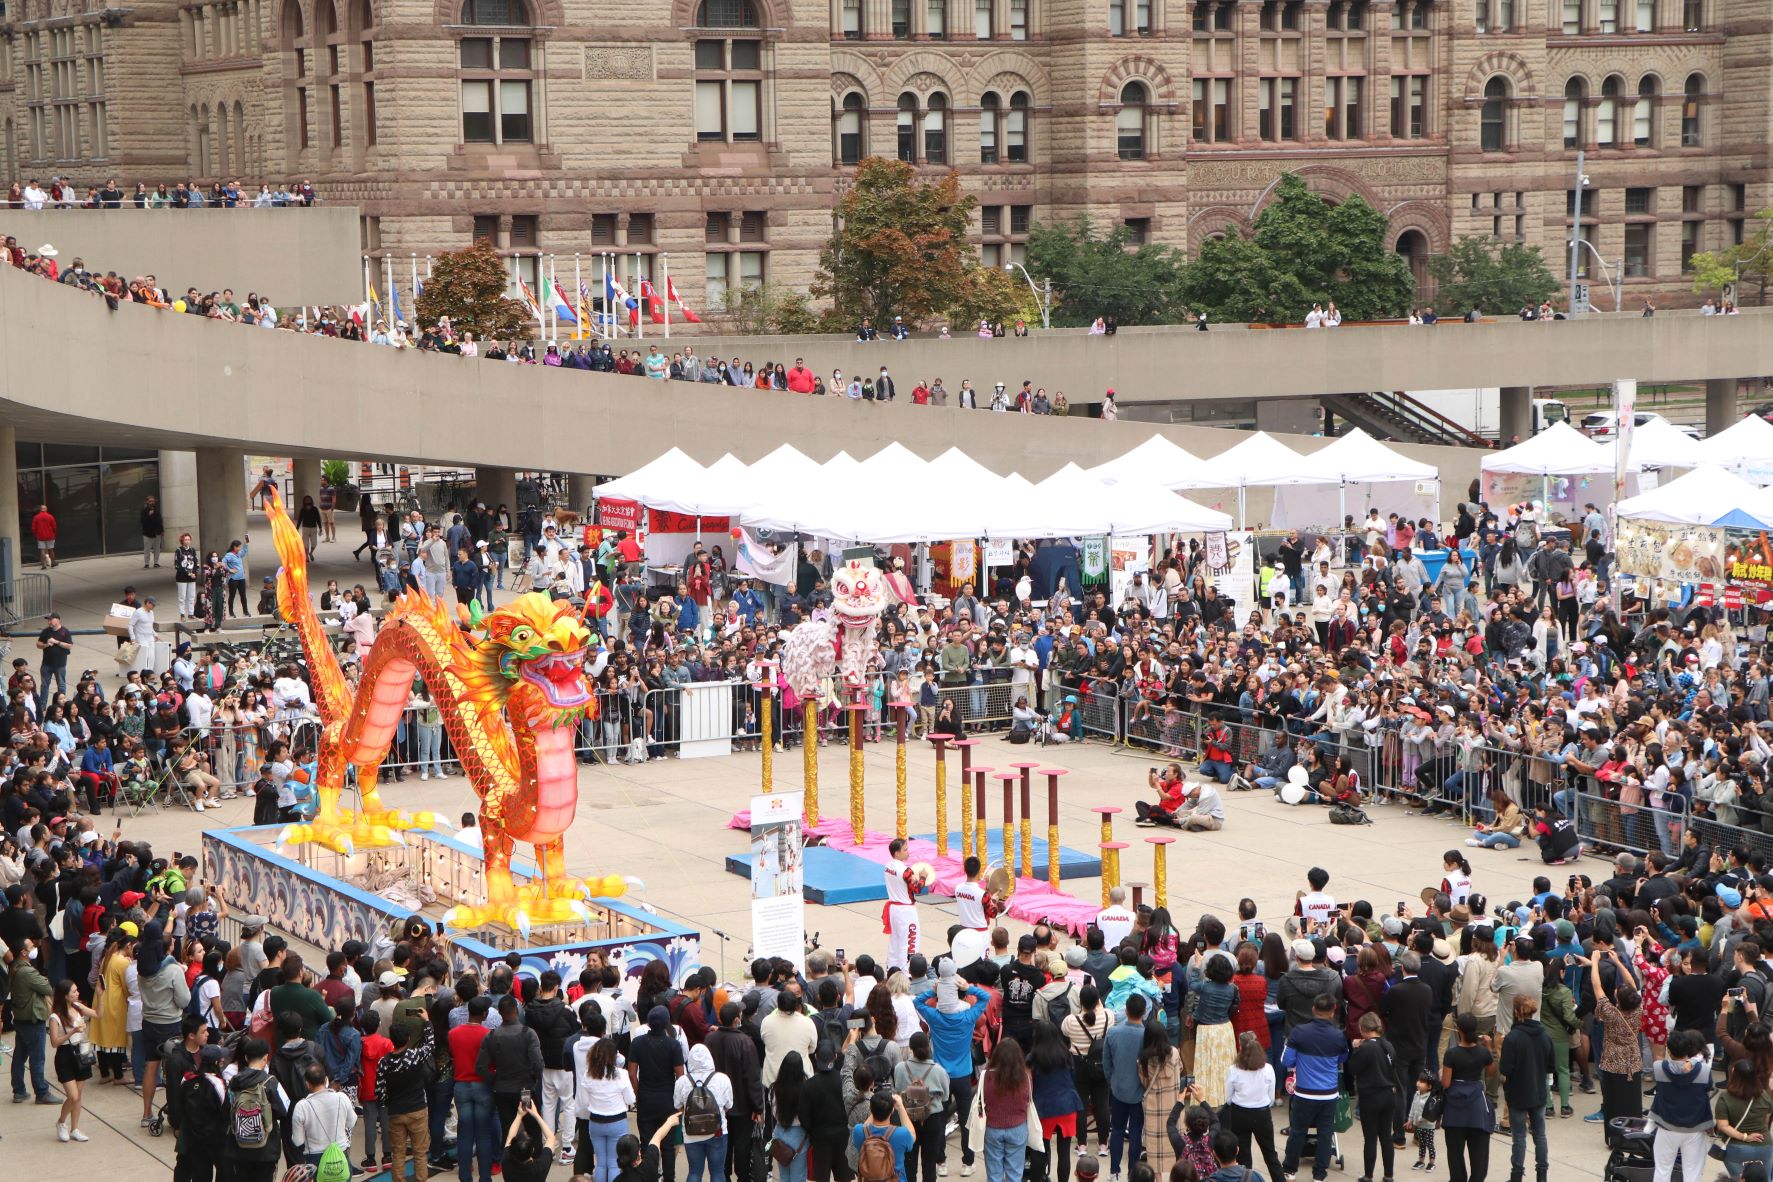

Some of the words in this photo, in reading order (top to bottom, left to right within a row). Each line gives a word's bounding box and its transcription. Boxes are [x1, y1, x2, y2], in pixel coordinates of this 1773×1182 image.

[1199, 166, 1271, 181] COURT
[957, 891, 975, 901] CANADA
[908, 923, 917, 955] CANA
